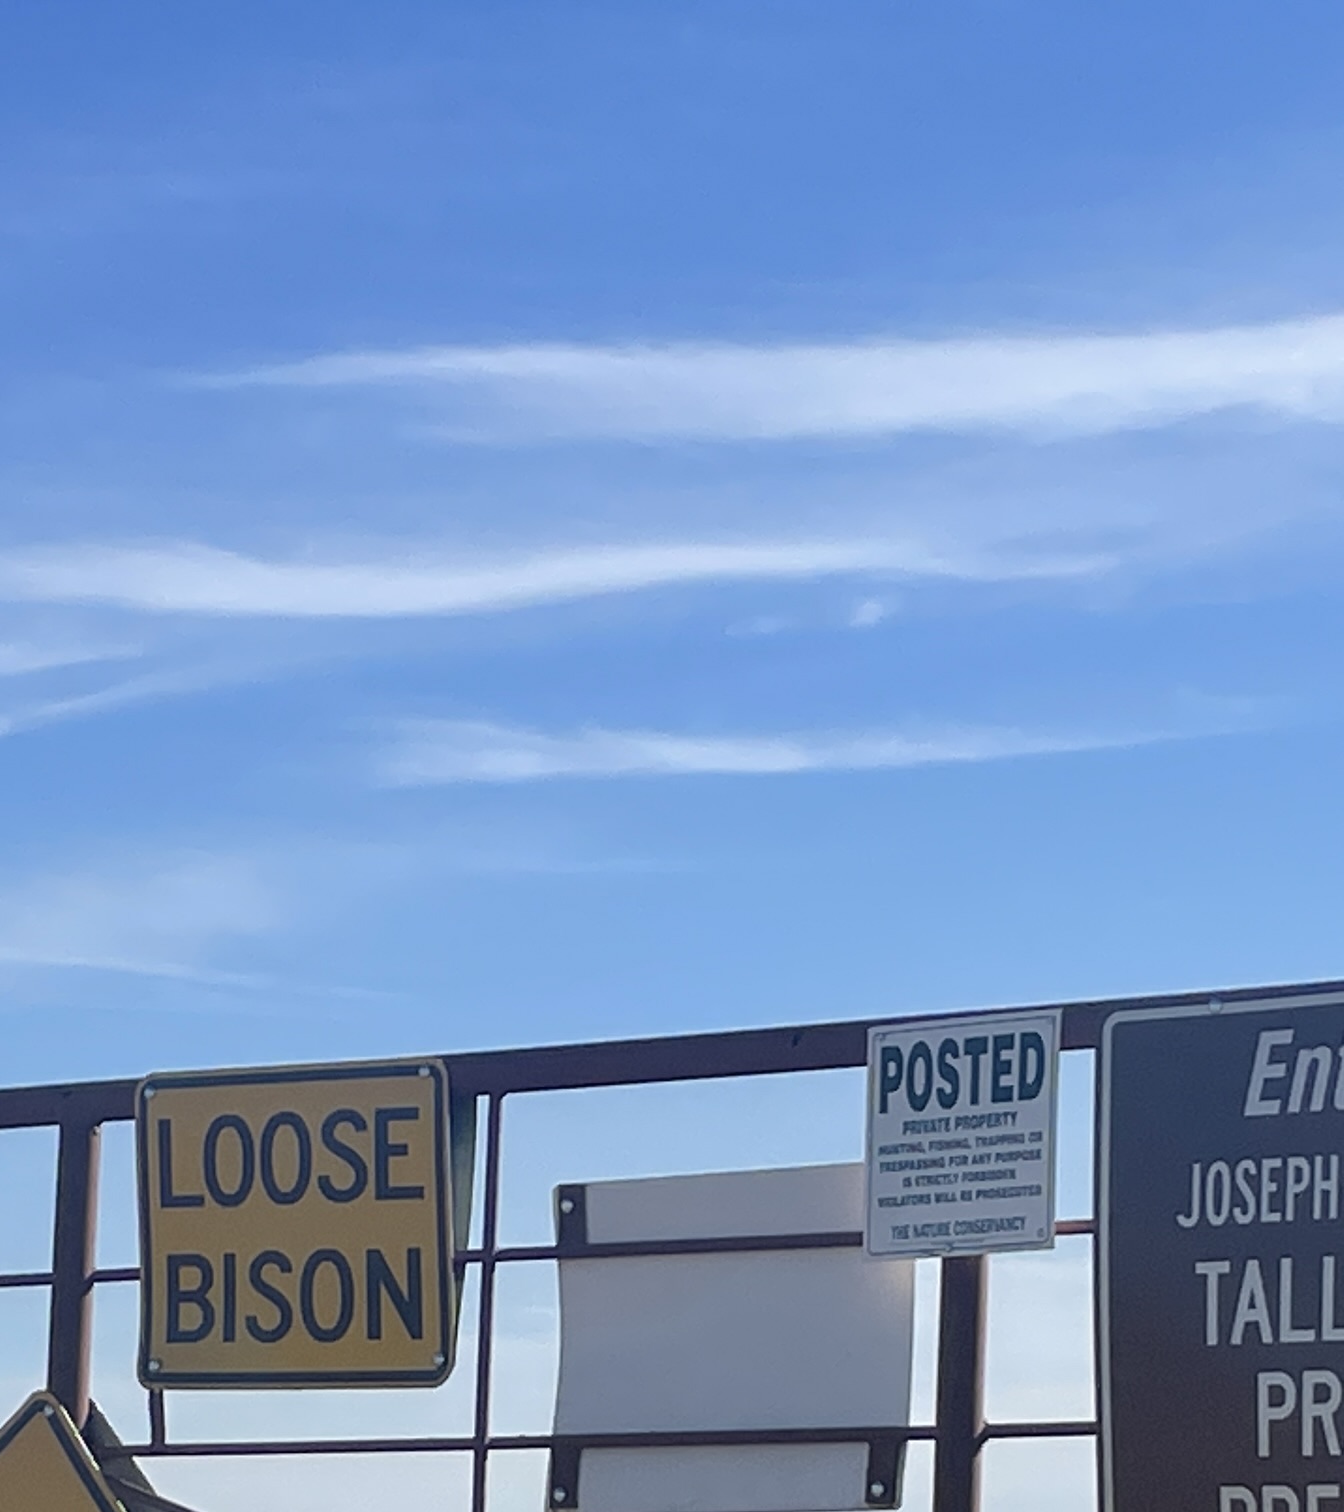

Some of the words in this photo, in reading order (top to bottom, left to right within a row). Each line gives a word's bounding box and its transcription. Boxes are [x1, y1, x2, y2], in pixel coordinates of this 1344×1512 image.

[879, 1031, 1046, 1114] POSTED
[902, 1117, 951, 1135] PRIVATE
[954, 1111, 1018, 1131] PROPERTY
[975, 1133, 1025, 1148] TRAPPING
[158, 1106, 425, 1209] LOOSE
[879, 1156, 945, 1174] TRESPASSING
[948, 1154, 969, 1168] FOR
[971, 1152, 992, 1165] ANY
[994, 1149, 1042, 1162] PURPOSE
[902, 1177, 913, 1188] IS
[914, 1173, 959, 1187] STRICTLY
[961, 1169, 1017, 1183] FORBIDDEN
[877, 1193, 931, 1208] VIOLATORS
[934, 1191, 957, 1204] WILL
[960, 1190, 973, 1201] BE
[975, 1184, 1042, 1200] PROSECUTED
[1176, 1154, 1340, 1228] JOSEPH
[891, 1224, 909, 1240] THE
[913, 1220, 952, 1238] NATURE
[954, 1216, 1026, 1235] CONSERVANCY
[165, 1247, 424, 1344] BISON
